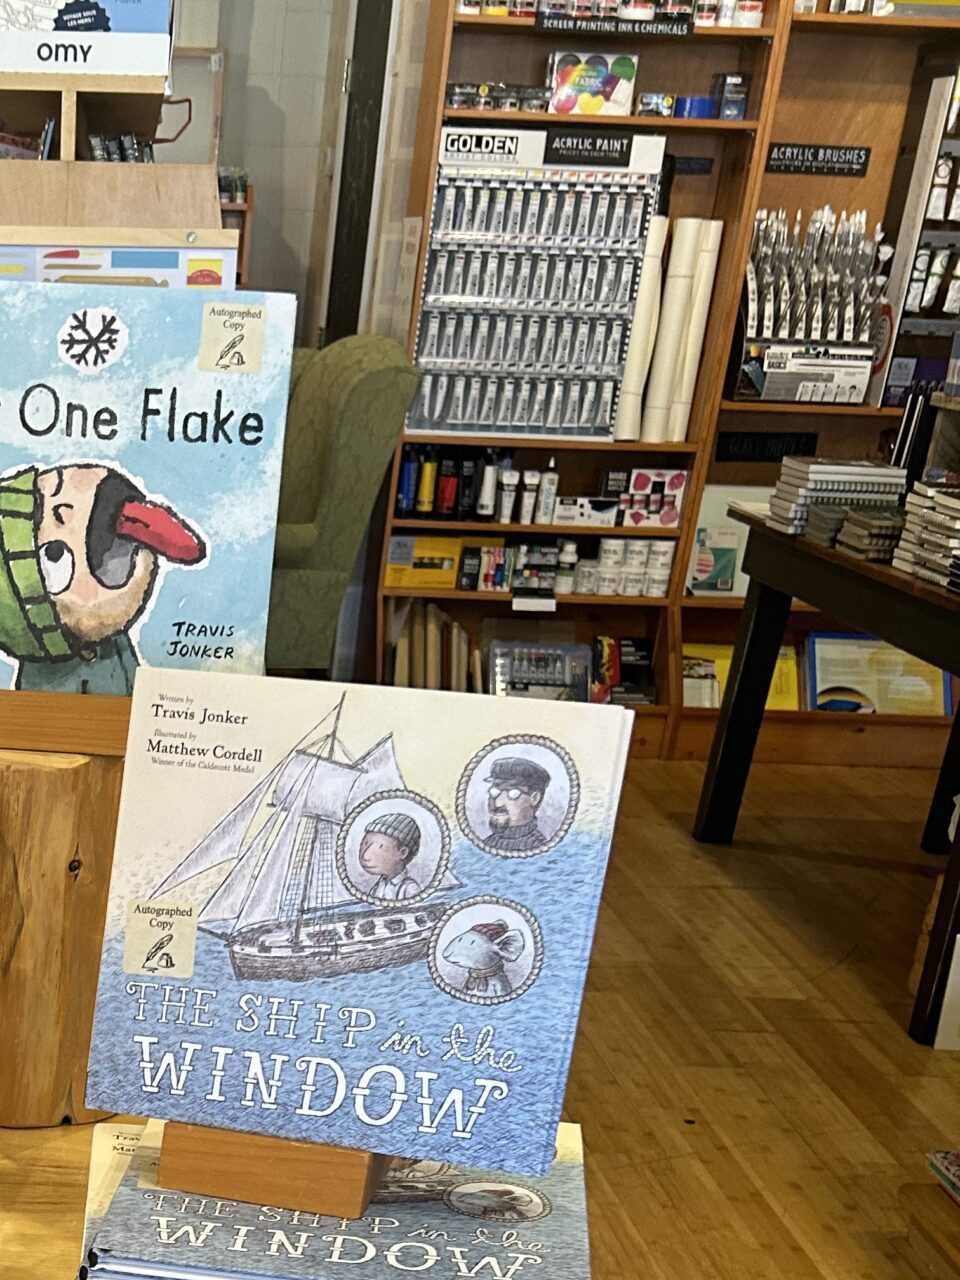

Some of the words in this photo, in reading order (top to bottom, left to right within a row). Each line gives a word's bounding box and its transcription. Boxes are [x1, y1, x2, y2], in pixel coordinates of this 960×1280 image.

[543, 18, 574, 30] SCREEN
[576, 20, 616, 32] PRINTING
[641, 23, 688, 35] CHEMICALS
[446, 134, 517, 154] GOLDEN
[552, 137, 593, 149] ACRYLIC
[595, 138, 630, 152] PAINT
[771, 146, 815, 160] ACRYLIC
[818, 148, 866, 163] BRUSHES
[209, 306, 262, 320] Autographed
[223, 319, 246, 332] Copy
[19, 382, 119, 441] One
[140, 386, 265, 446] Flake
[171, 620, 235, 638] TRAVIS
[166, 640, 234, 659] JONKER
[158, 693, 185, 704] Written
[185, 695, 194, 705] by
[151, 703, 196, 721] Travis
[199, 708, 248, 725] Jonker
[188, 731, 197, 742] by
[146, 738, 210, 757] Matthew
[212, 745, 263, 763] Cordell
[151, 756, 176, 767] Winner
[176, 759, 185, 768] of
[185, 760, 196, 769] the
[198, 761, 231, 772] Caldecott
[232, 764, 255, 774] Medal
[133, 904, 193, 919] Autographed
[149, 917, 175, 931] Copy
[126, 980, 219, 1028] THE
[235, 992, 377, 1049] SHIP
[379, 1019, 430, 1058] in
[442, 1022, 523, 1073] the
[133, 1034, 509, 1140] WINDOW
[143, 1193, 238, 1219] THE
[407, 1223, 457, 1242] in
[468, 1227, 552, 1253] the
[150, 1215, 543, 1280] WINDOW
